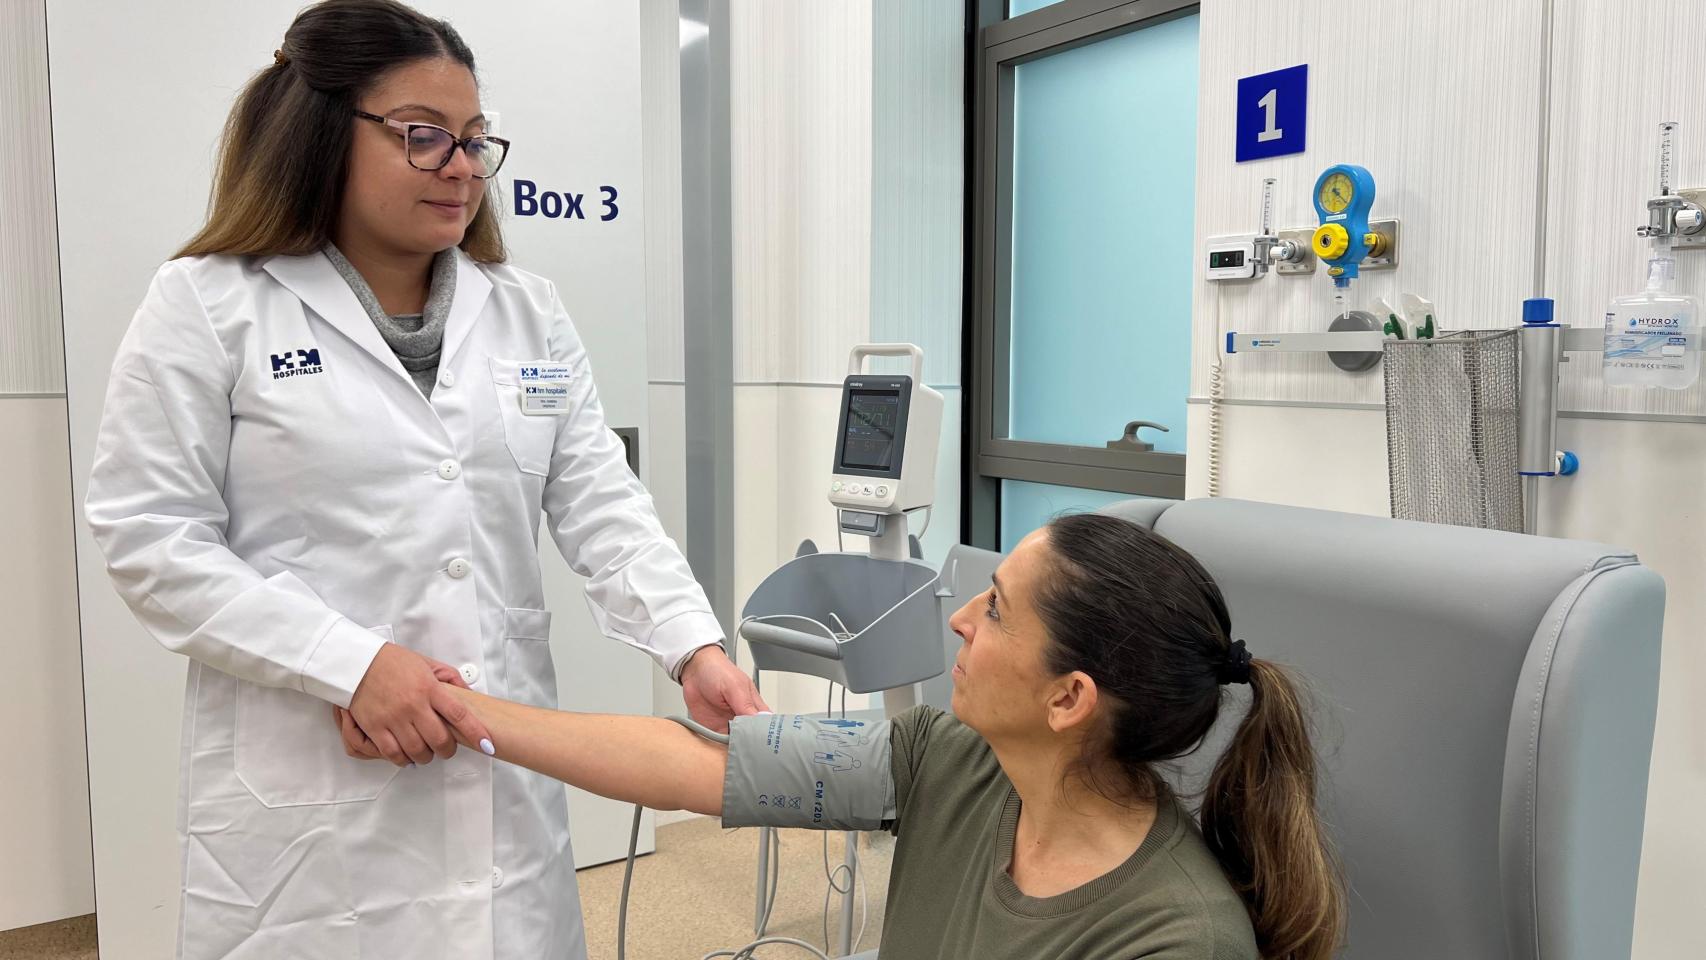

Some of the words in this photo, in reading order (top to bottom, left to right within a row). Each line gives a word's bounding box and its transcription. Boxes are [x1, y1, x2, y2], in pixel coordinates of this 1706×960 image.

[1257, 88, 1283, 143] 1
[513, 179, 585, 220] Box
[599, 185, 619, 222] 3
[271, 349, 321, 371] HM
[273, 366, 323, 380] HOSPITALES
